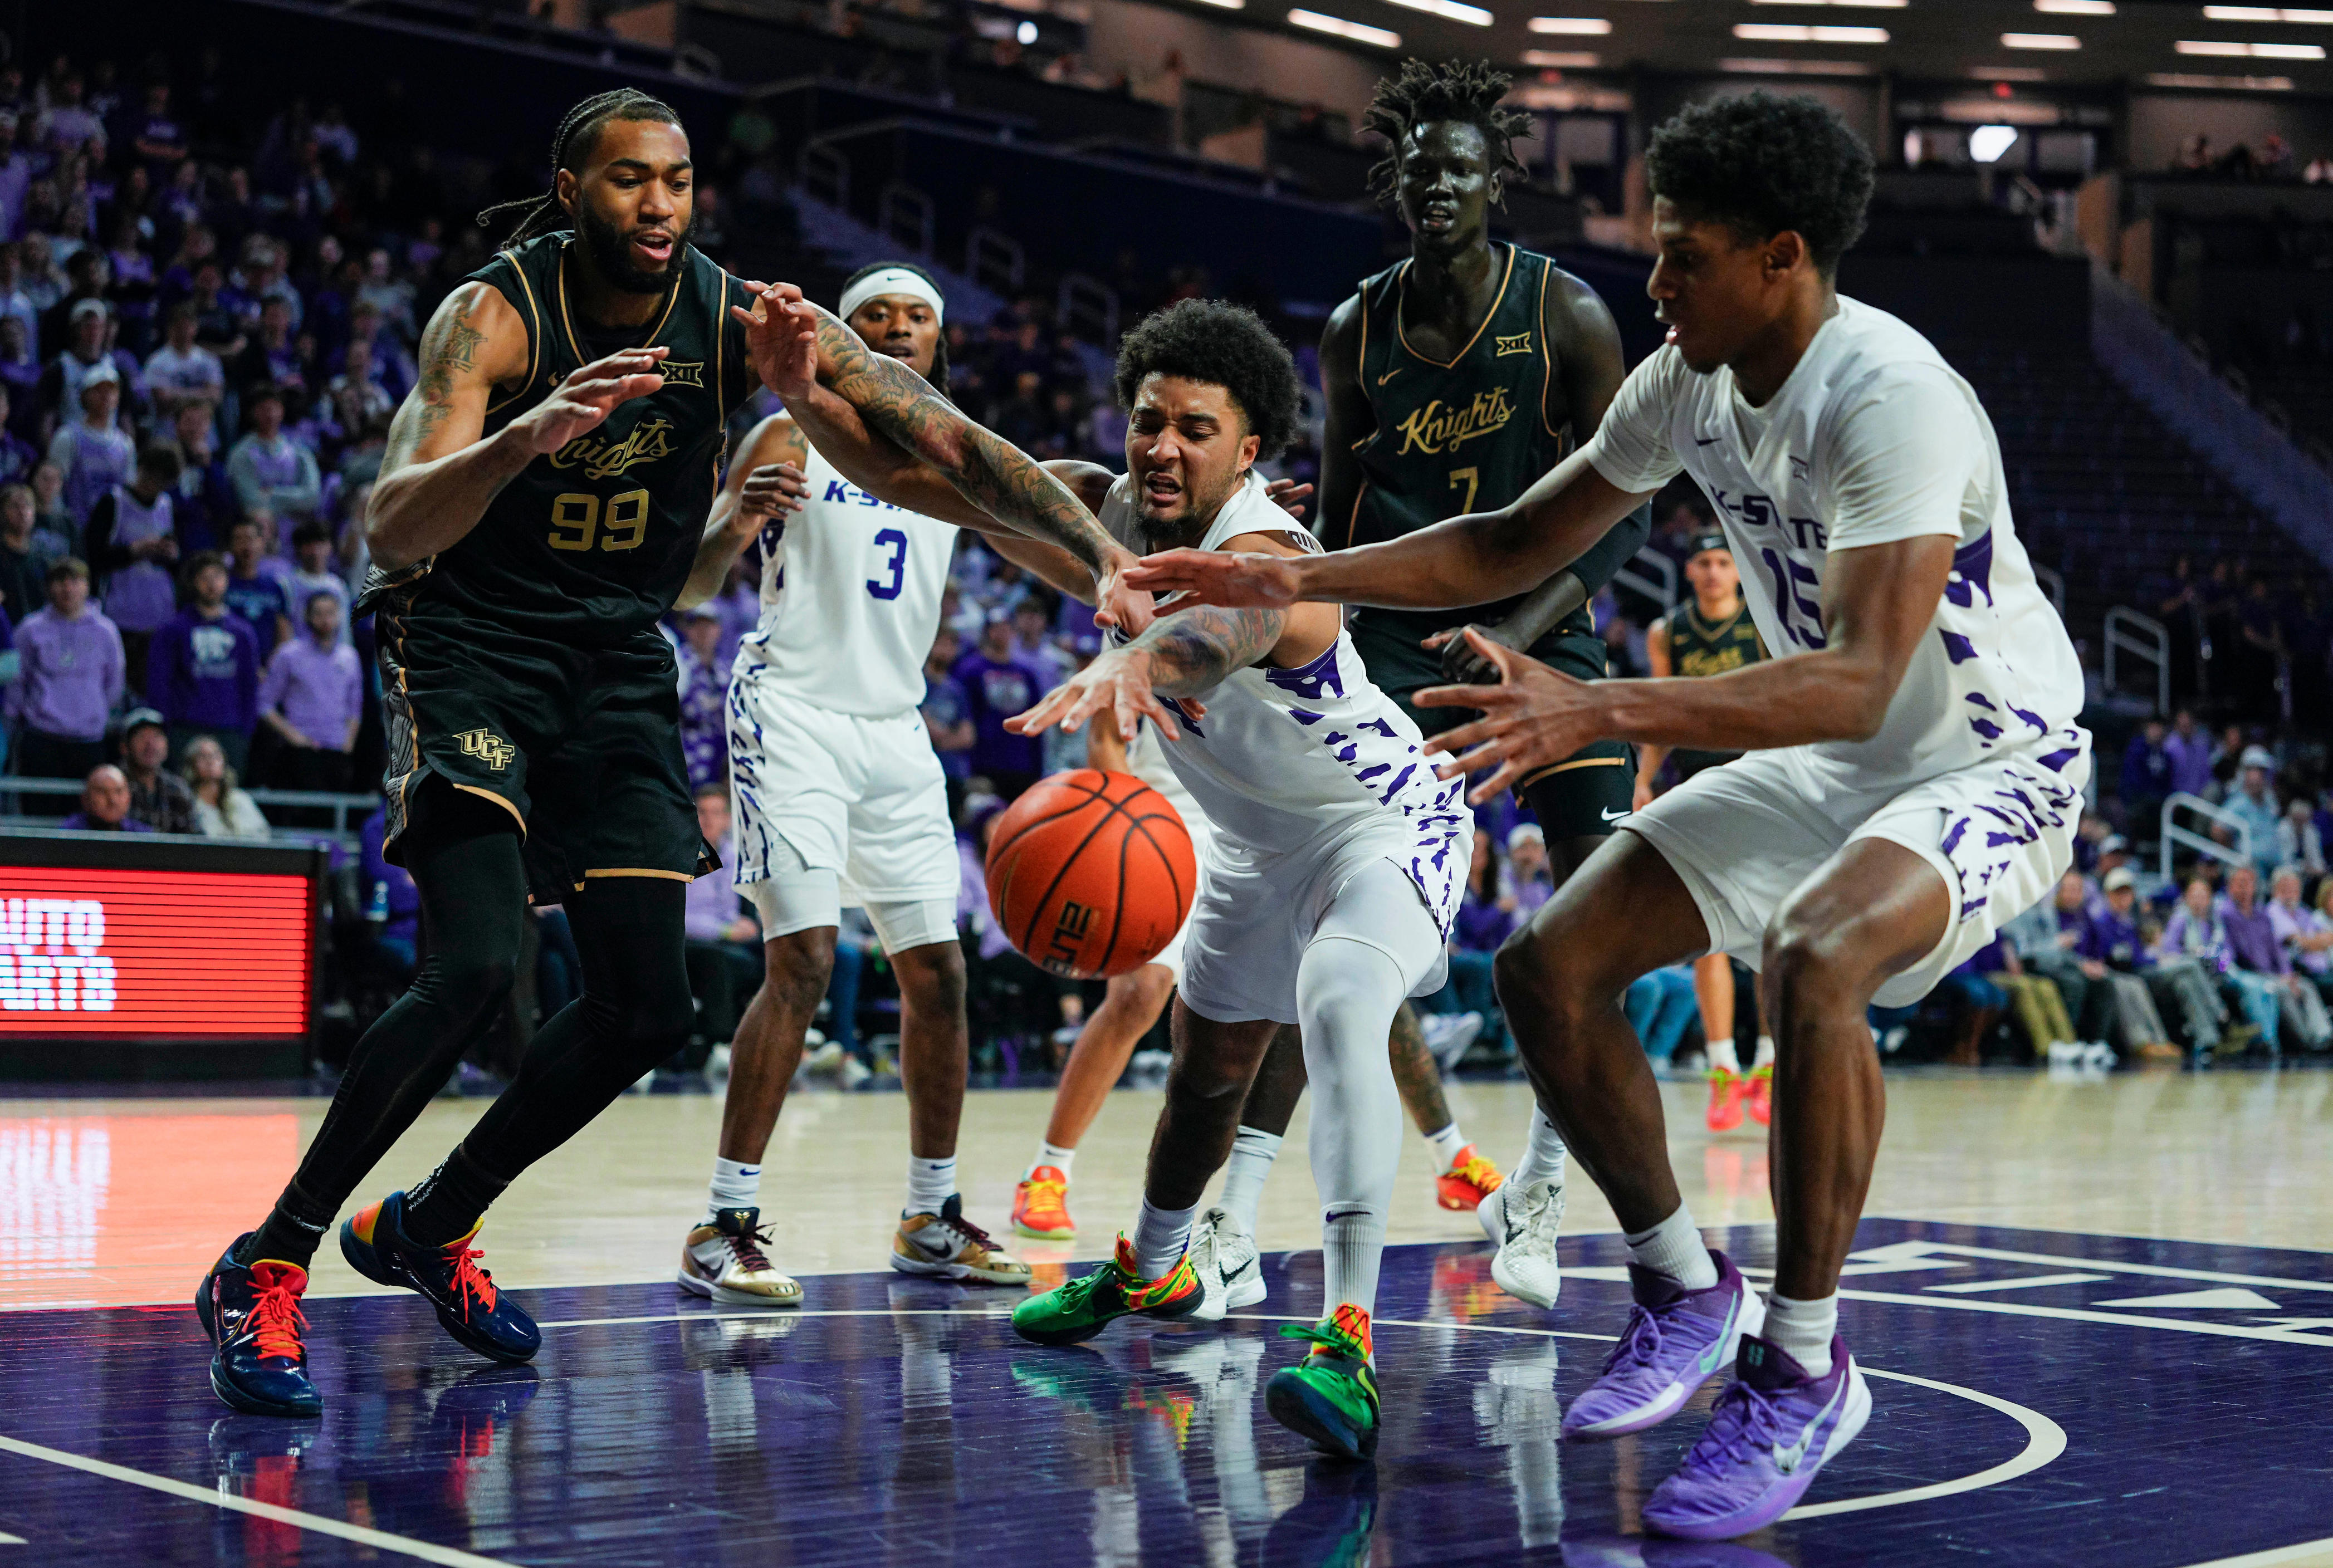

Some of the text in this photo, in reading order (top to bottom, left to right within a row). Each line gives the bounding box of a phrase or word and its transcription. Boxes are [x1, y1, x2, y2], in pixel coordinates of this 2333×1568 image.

[549, 419, 678, 480] nights
[1396, 386, 1516, 455] Knights
[548, 488, 649, 551] 99
[1450, 467, 1478, 514] 7
[866, 528, 907, 600] 3
[1762, 547, 1827, 649] 15
[453, 728, 515, 770] UCF
[0, 898, 105, 955] UTO
